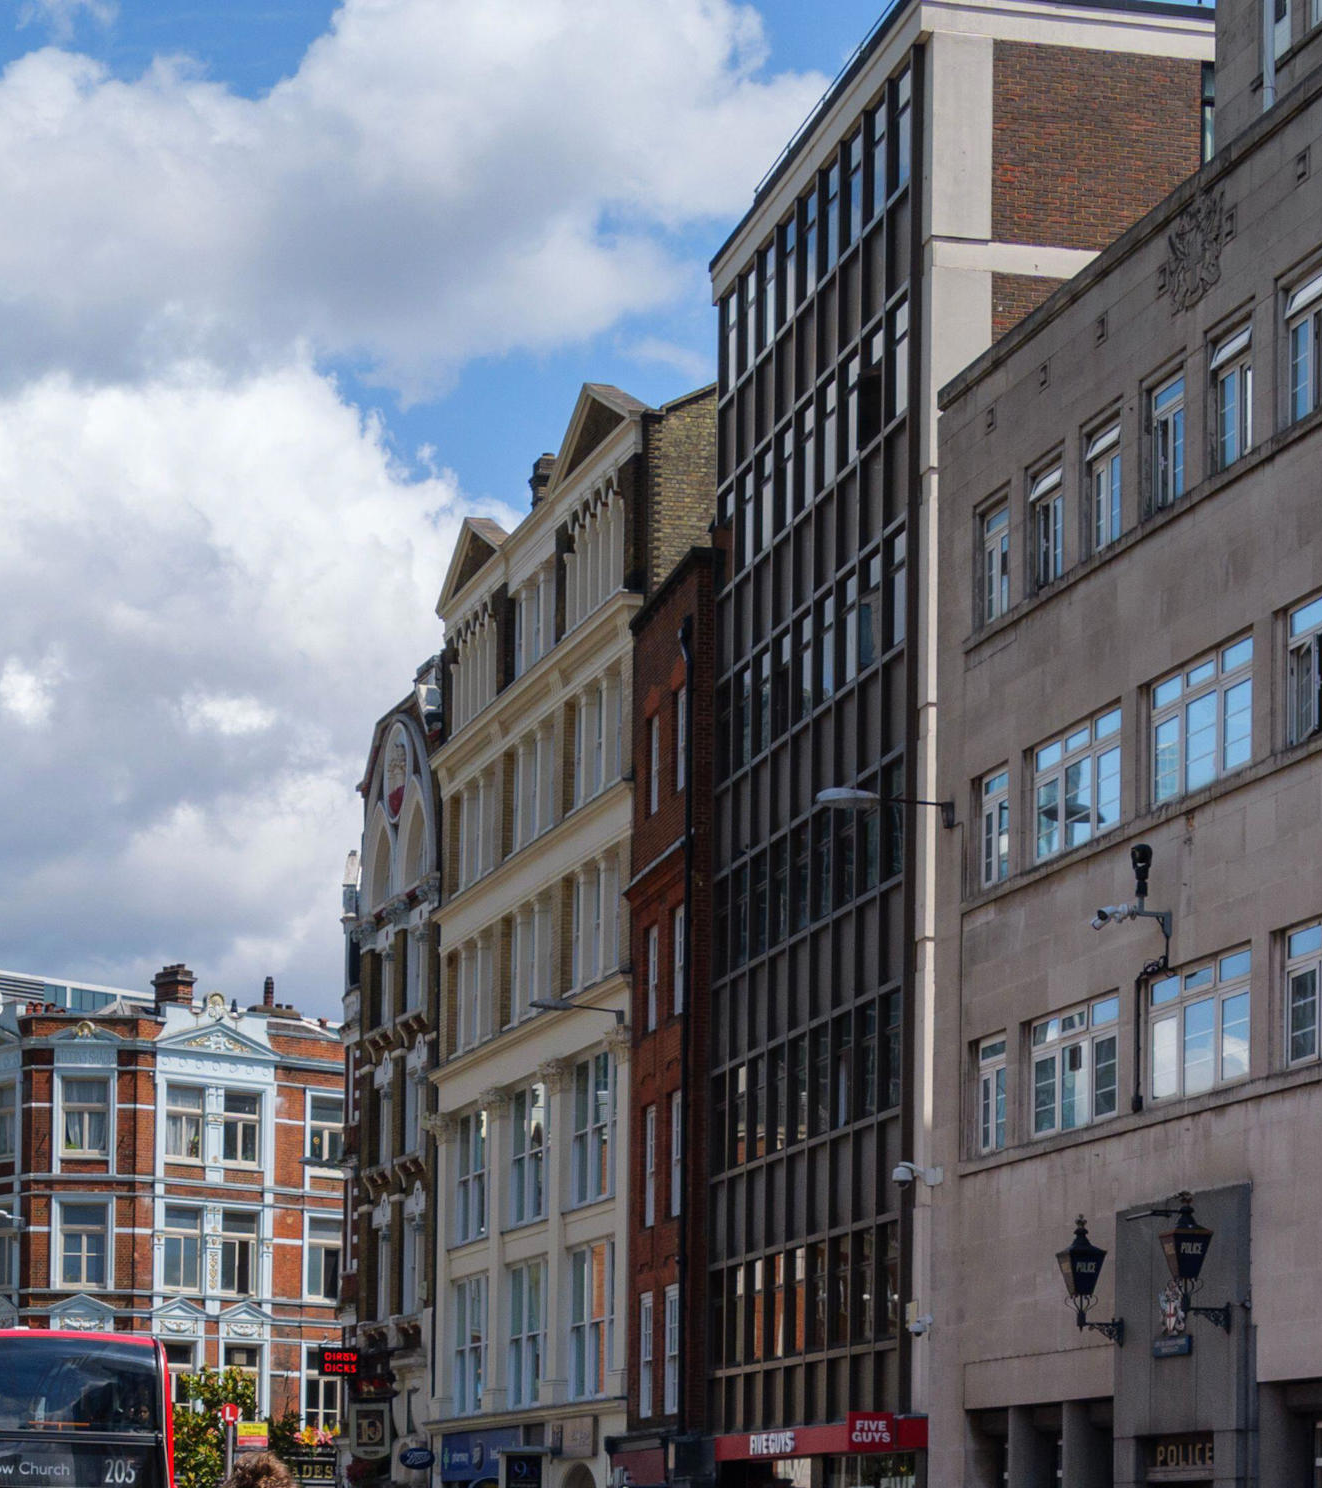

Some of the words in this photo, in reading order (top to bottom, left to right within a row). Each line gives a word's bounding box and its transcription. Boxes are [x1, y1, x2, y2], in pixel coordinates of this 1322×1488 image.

[1180, 1241, 1204, 1255] POLICE
[1075, 1261, 1097, 1273] POLICE
[324, 1363, 357, 1374] DICKS
[226, 1406, 235, 1420] L
[856, 1420, 887, 1431] FIVE
[750, 1434, 769, 1456] FIVE
[769, 1431, 796, 1454] GUYS
[852, 1432, 891, 1443] GUYS
[1156, 1442, 1214, 1467] POLICE
[18, 1461, 71, 1477] Church
[104, 1458, 137, 1484] 205
